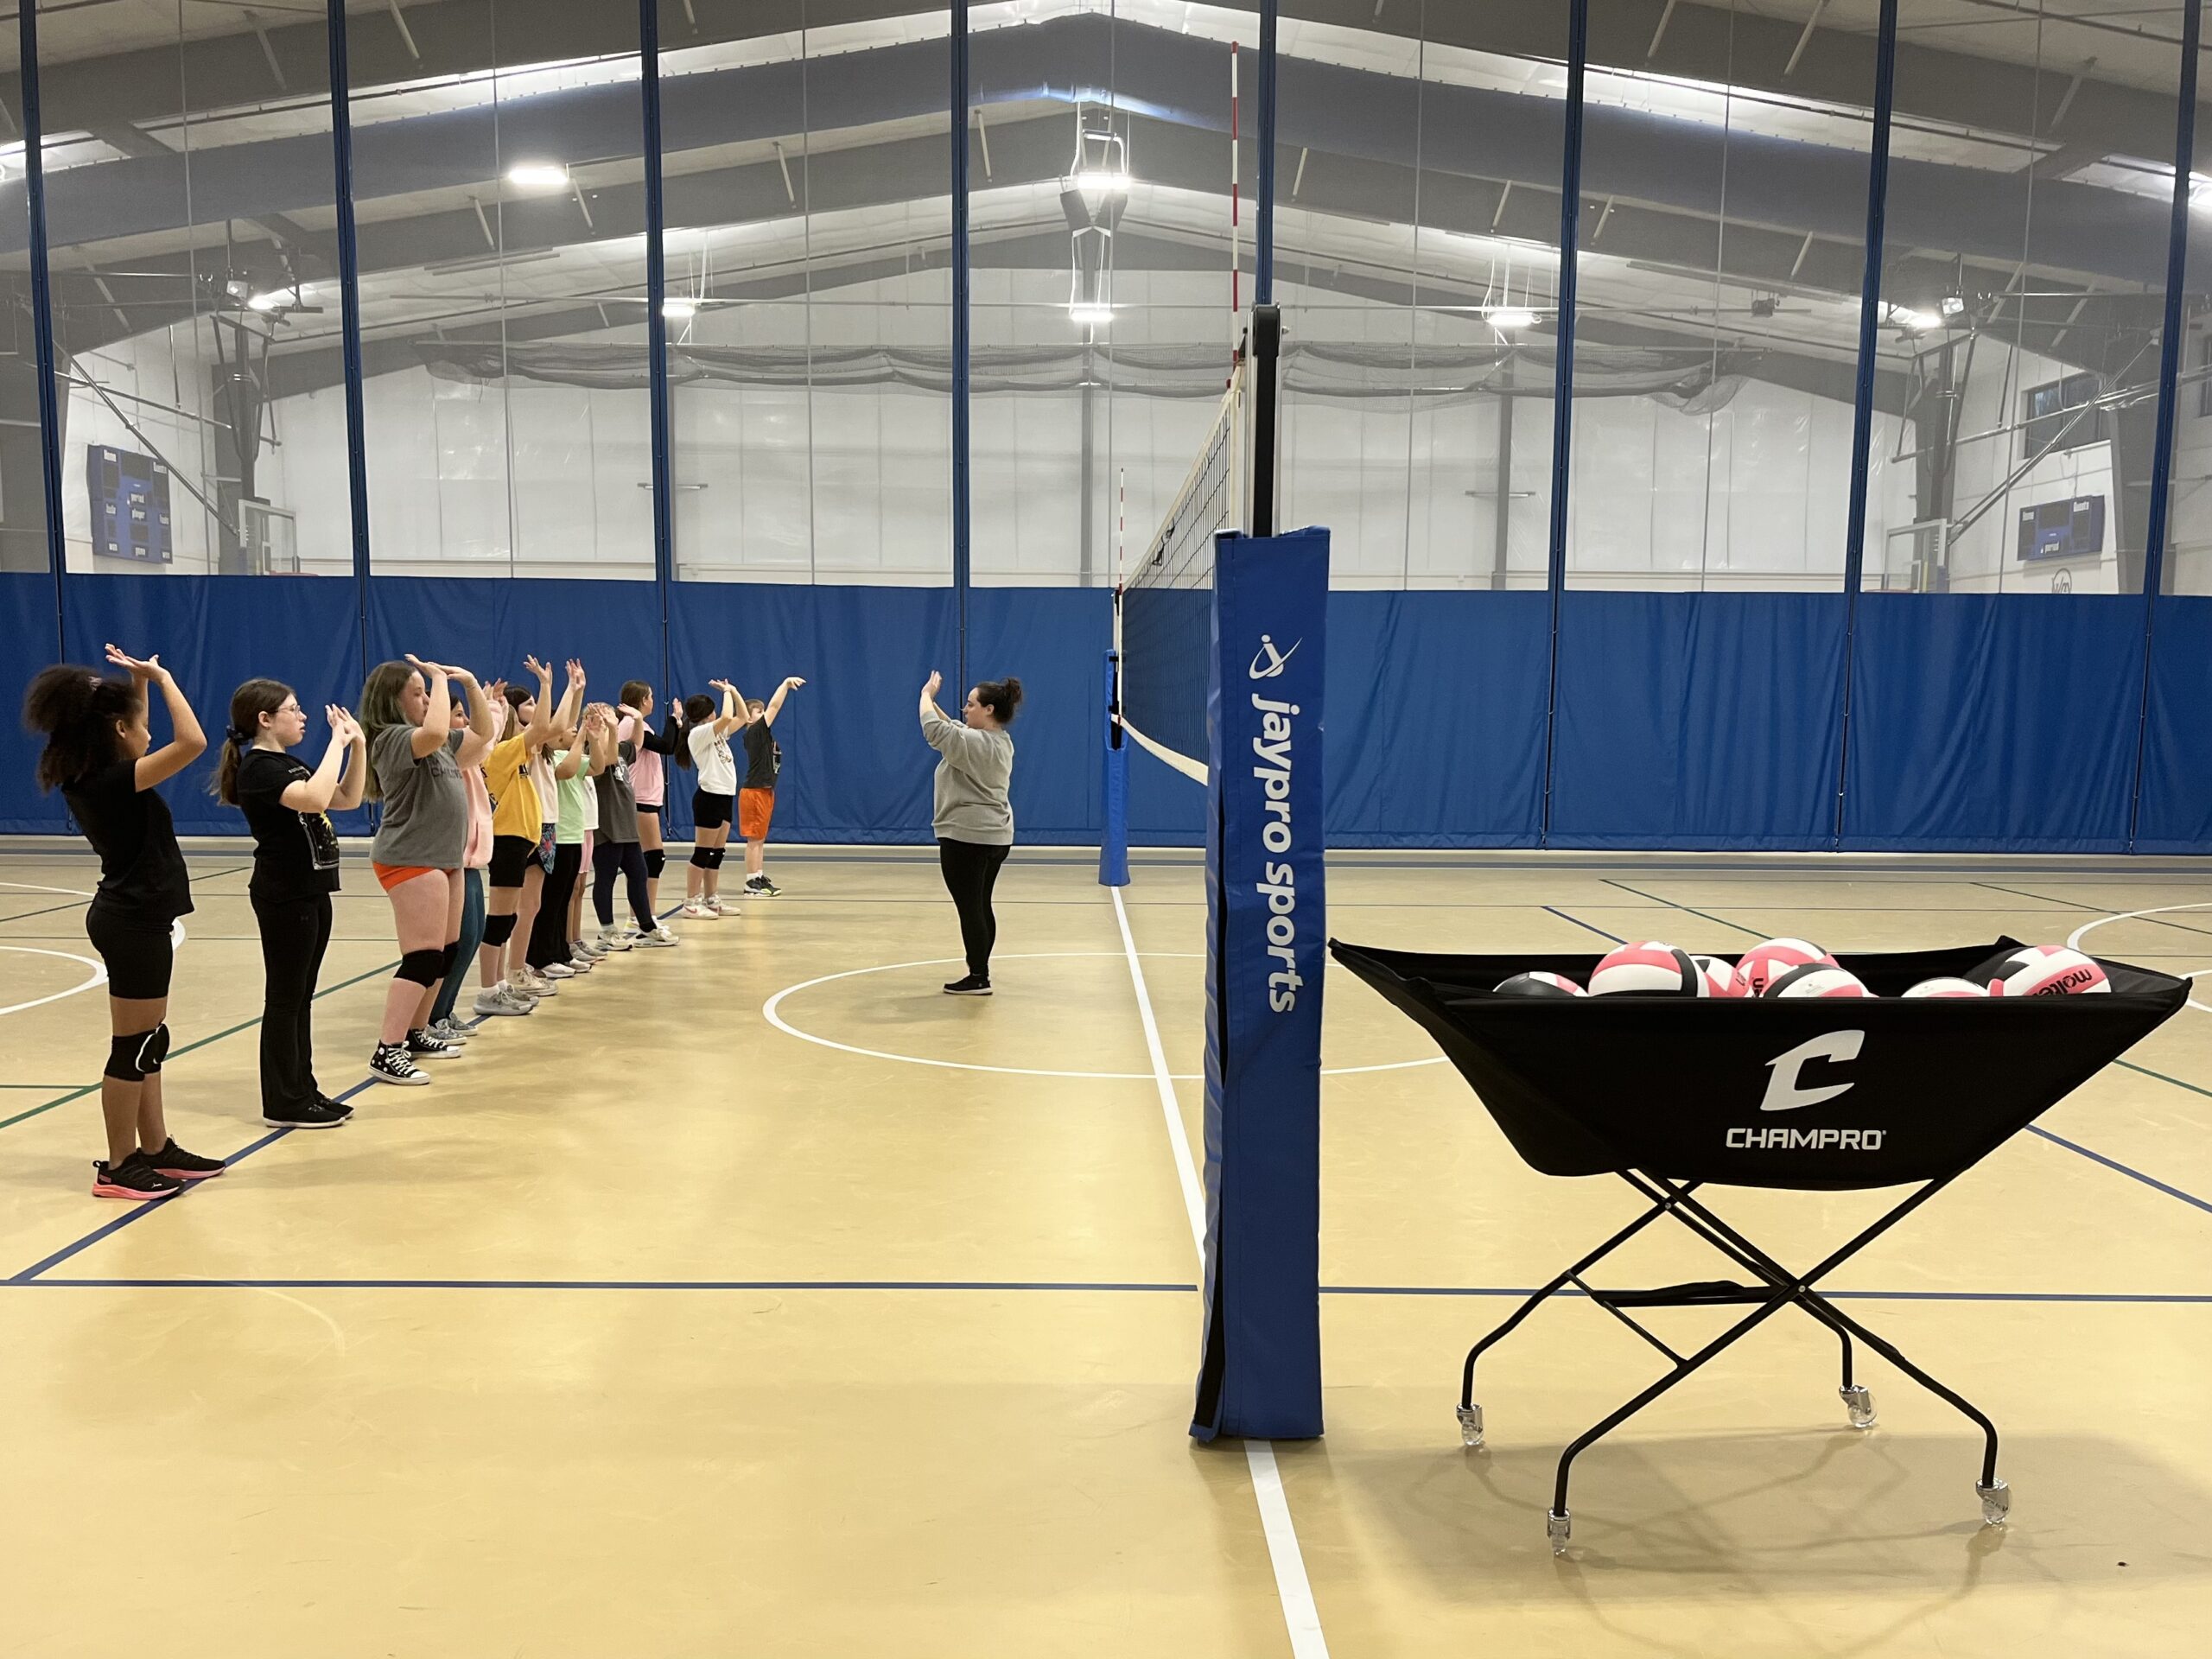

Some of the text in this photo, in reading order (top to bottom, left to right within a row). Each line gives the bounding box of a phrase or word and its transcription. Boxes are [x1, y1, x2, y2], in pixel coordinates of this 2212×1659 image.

[1251, 694, 1303, 1014] jaypro sports
[2033, 969, 2093, 996] molte
[1726, 1128, 1882, 1151] CHAMPRO
